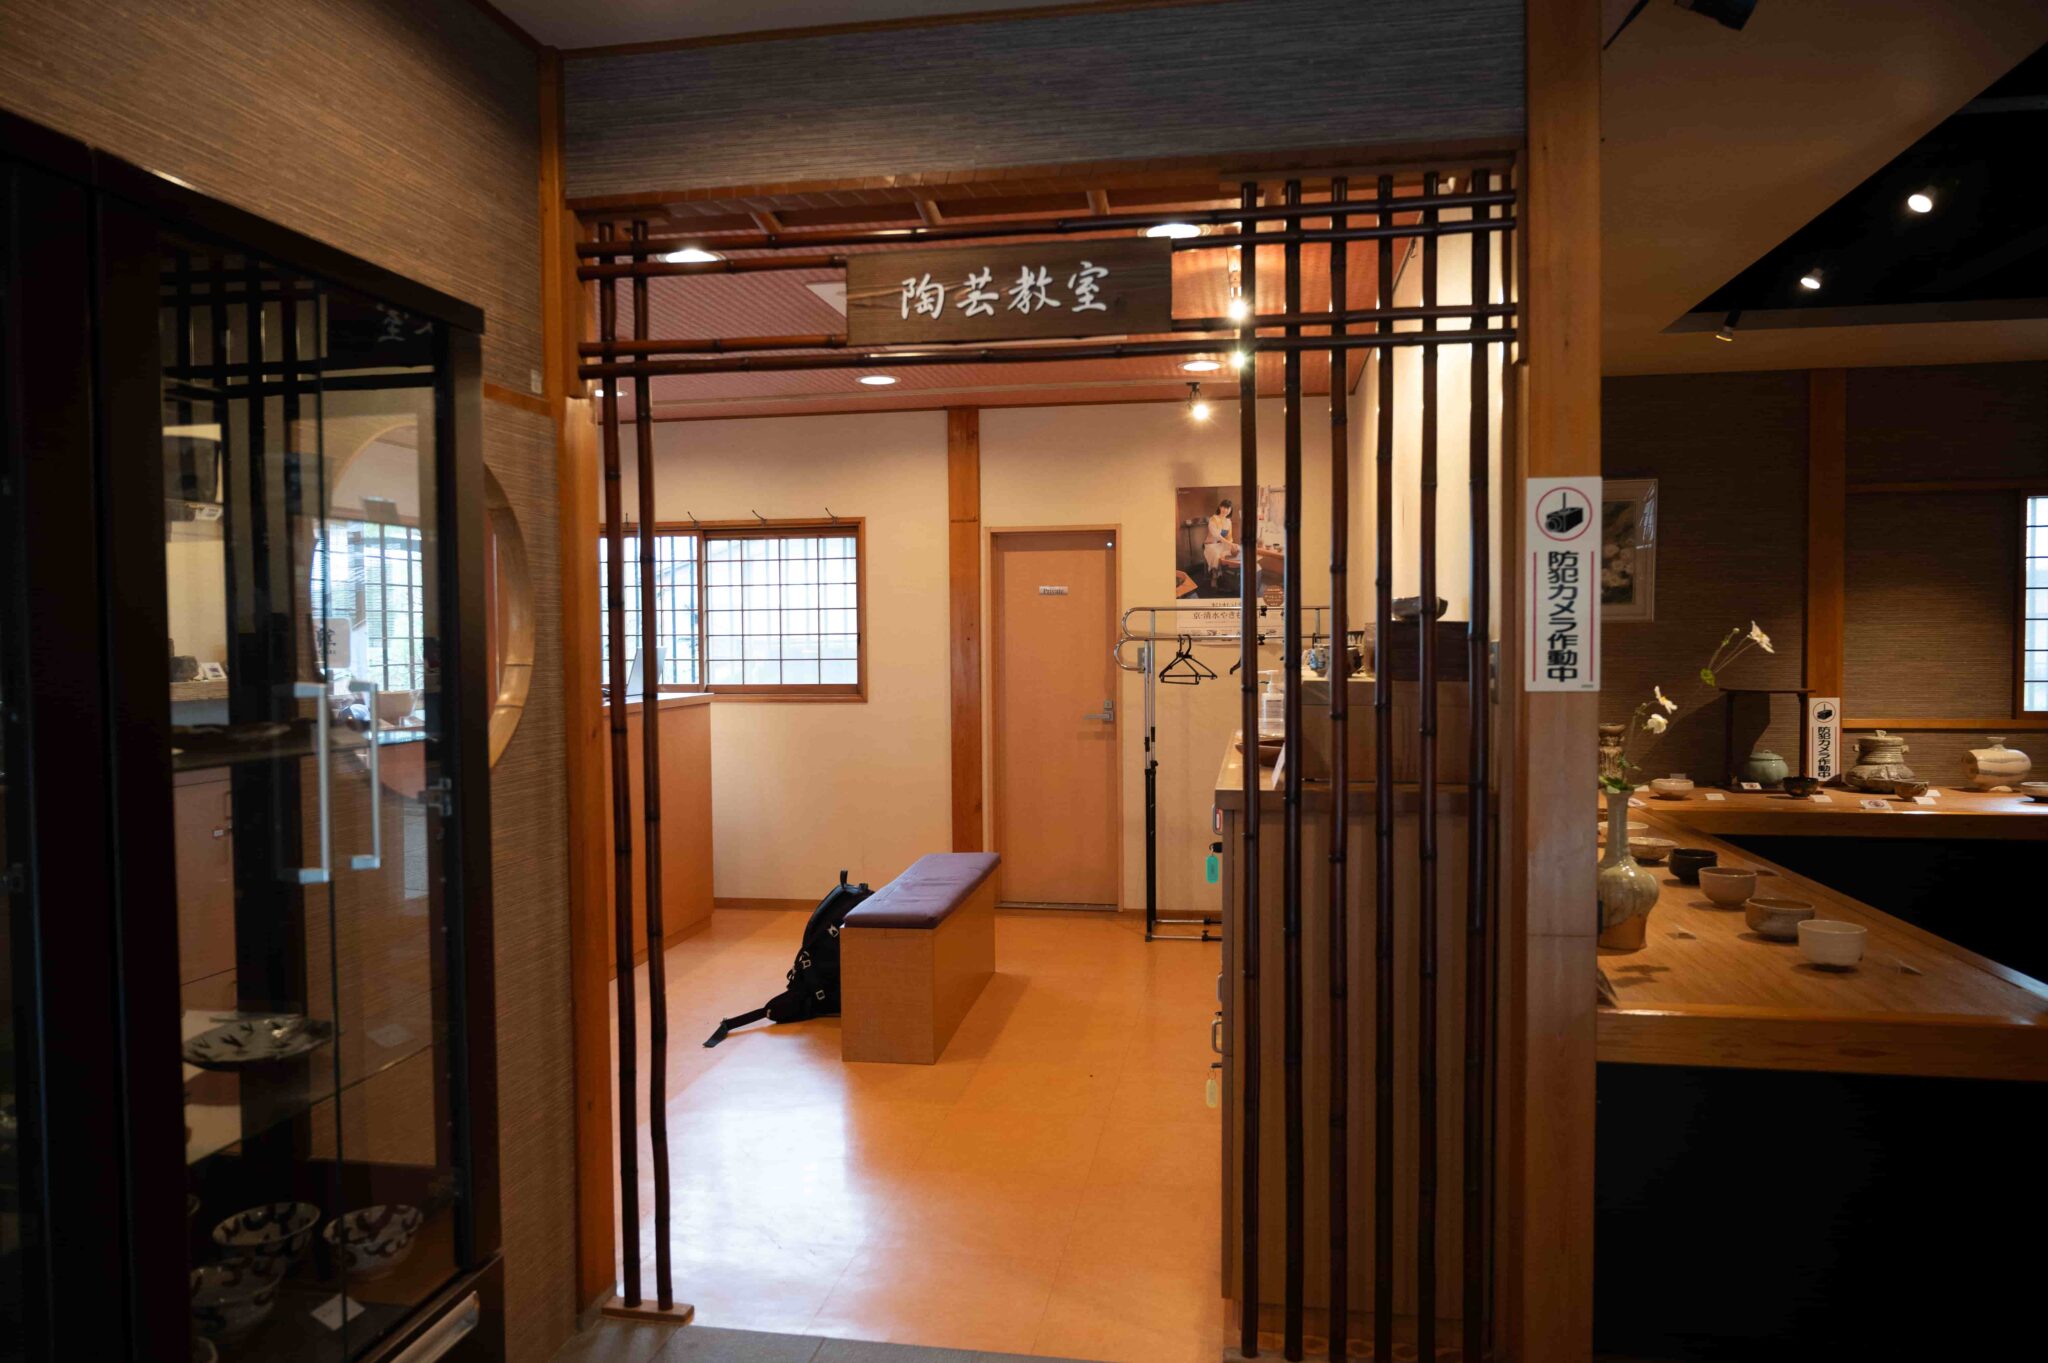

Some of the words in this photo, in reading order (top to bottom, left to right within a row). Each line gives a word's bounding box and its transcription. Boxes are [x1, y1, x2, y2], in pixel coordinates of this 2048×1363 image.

[901, 261, 1109, 320] 陶芸教室
[1547, 551, 1579, 683] 防犯カメラ作動中
[1817, 726, 1831, 778] 防犯カメラ作動中
